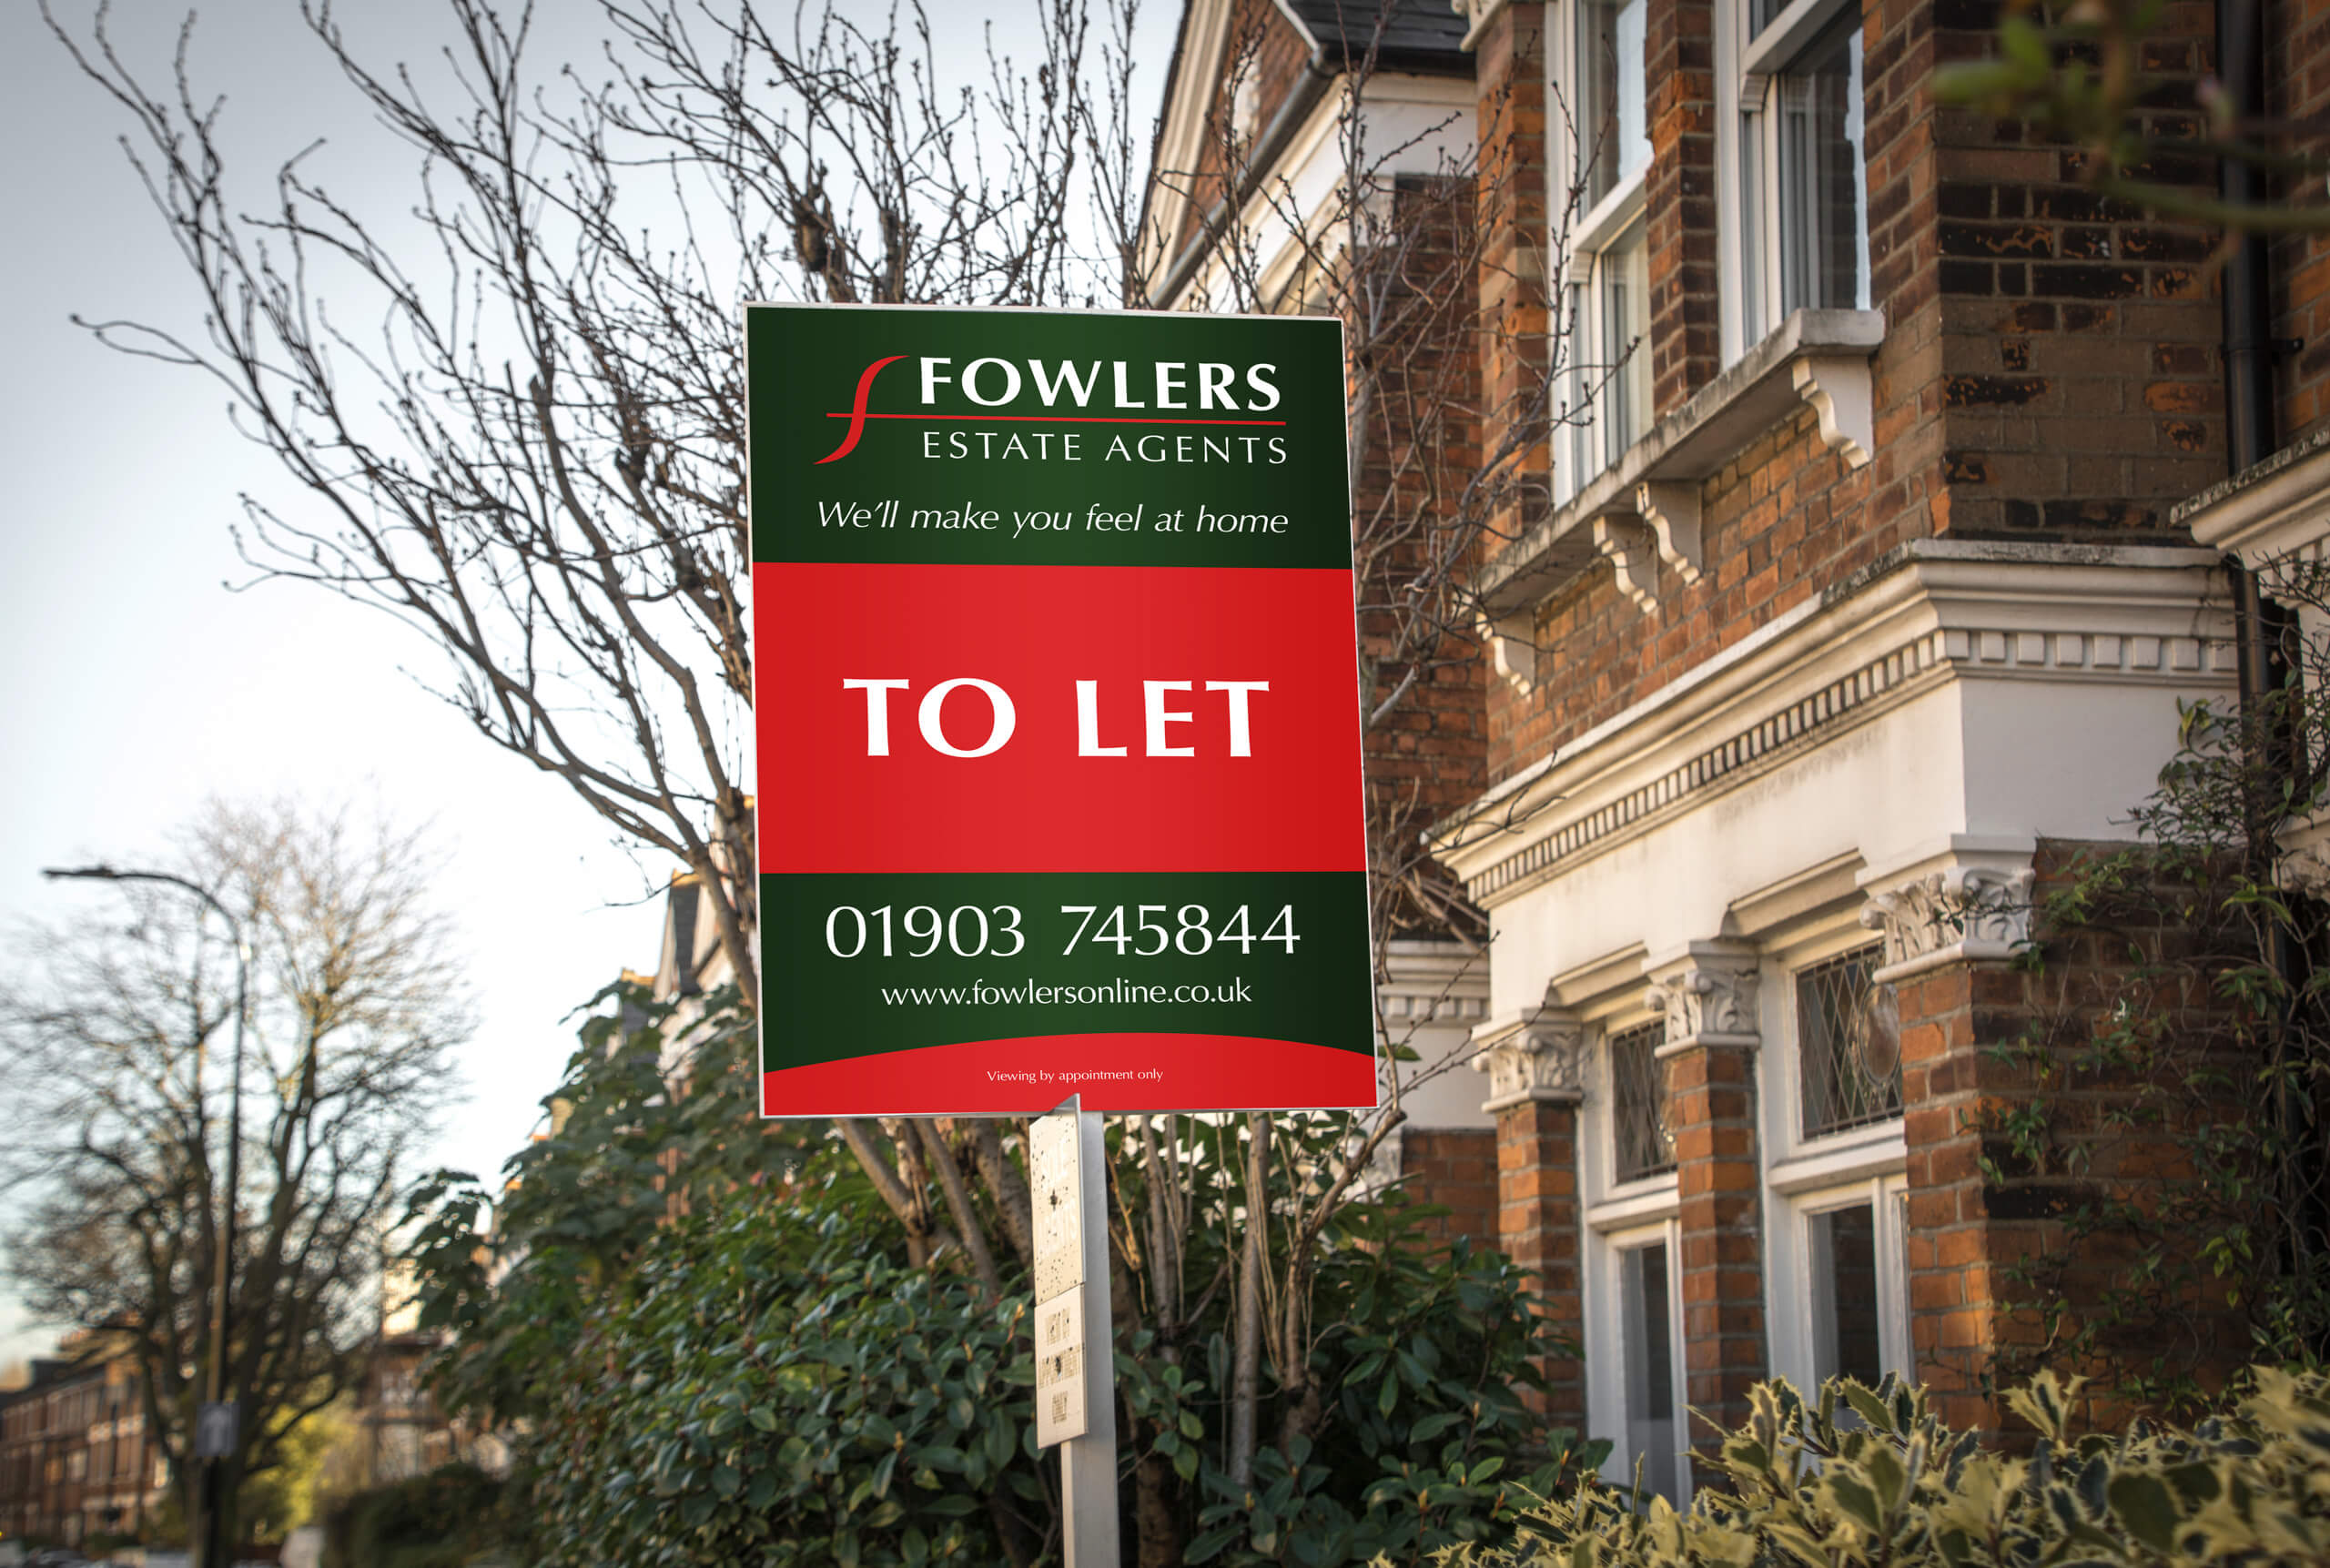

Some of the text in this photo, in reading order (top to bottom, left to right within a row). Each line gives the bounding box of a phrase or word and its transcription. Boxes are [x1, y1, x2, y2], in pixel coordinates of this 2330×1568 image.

[919, 356, 1281, 411] FOWLERS
[923, 431, 1287, 464] ESTATE AGENTS
[817, 501, 1289, 539] We’ll make you feel at home
[843, 677, 1270, 759] TO LET
[826, 904, 1301, 958] 01903 745844
[881, 976, 1252, 1006] www.fowlersonline.co.uk
[987, 1067, 1164, 1085] Viewing by appointment only
